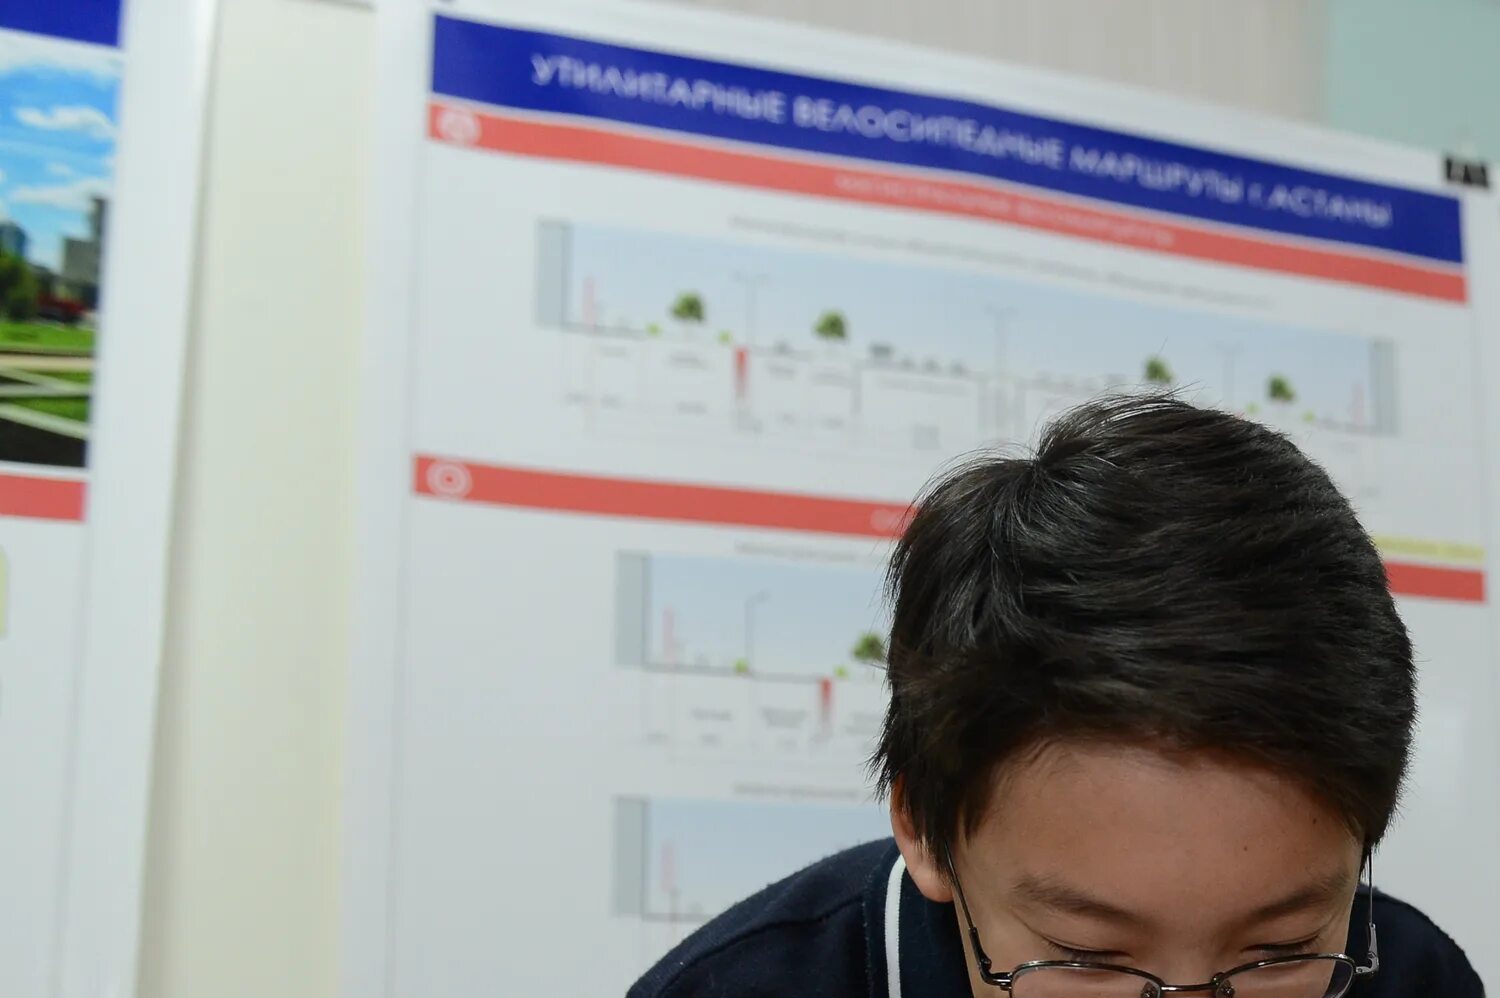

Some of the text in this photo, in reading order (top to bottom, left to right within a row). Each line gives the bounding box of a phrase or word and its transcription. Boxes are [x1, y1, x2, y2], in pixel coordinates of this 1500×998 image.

[531, 53, 787, 124] УТИЛИТАРНЫЕ
[793, 95, 1064, 170] ВЕЛОСИПЕДНЫЕ
[1069, 145, 1243, 204] МАРШРУТЫ
